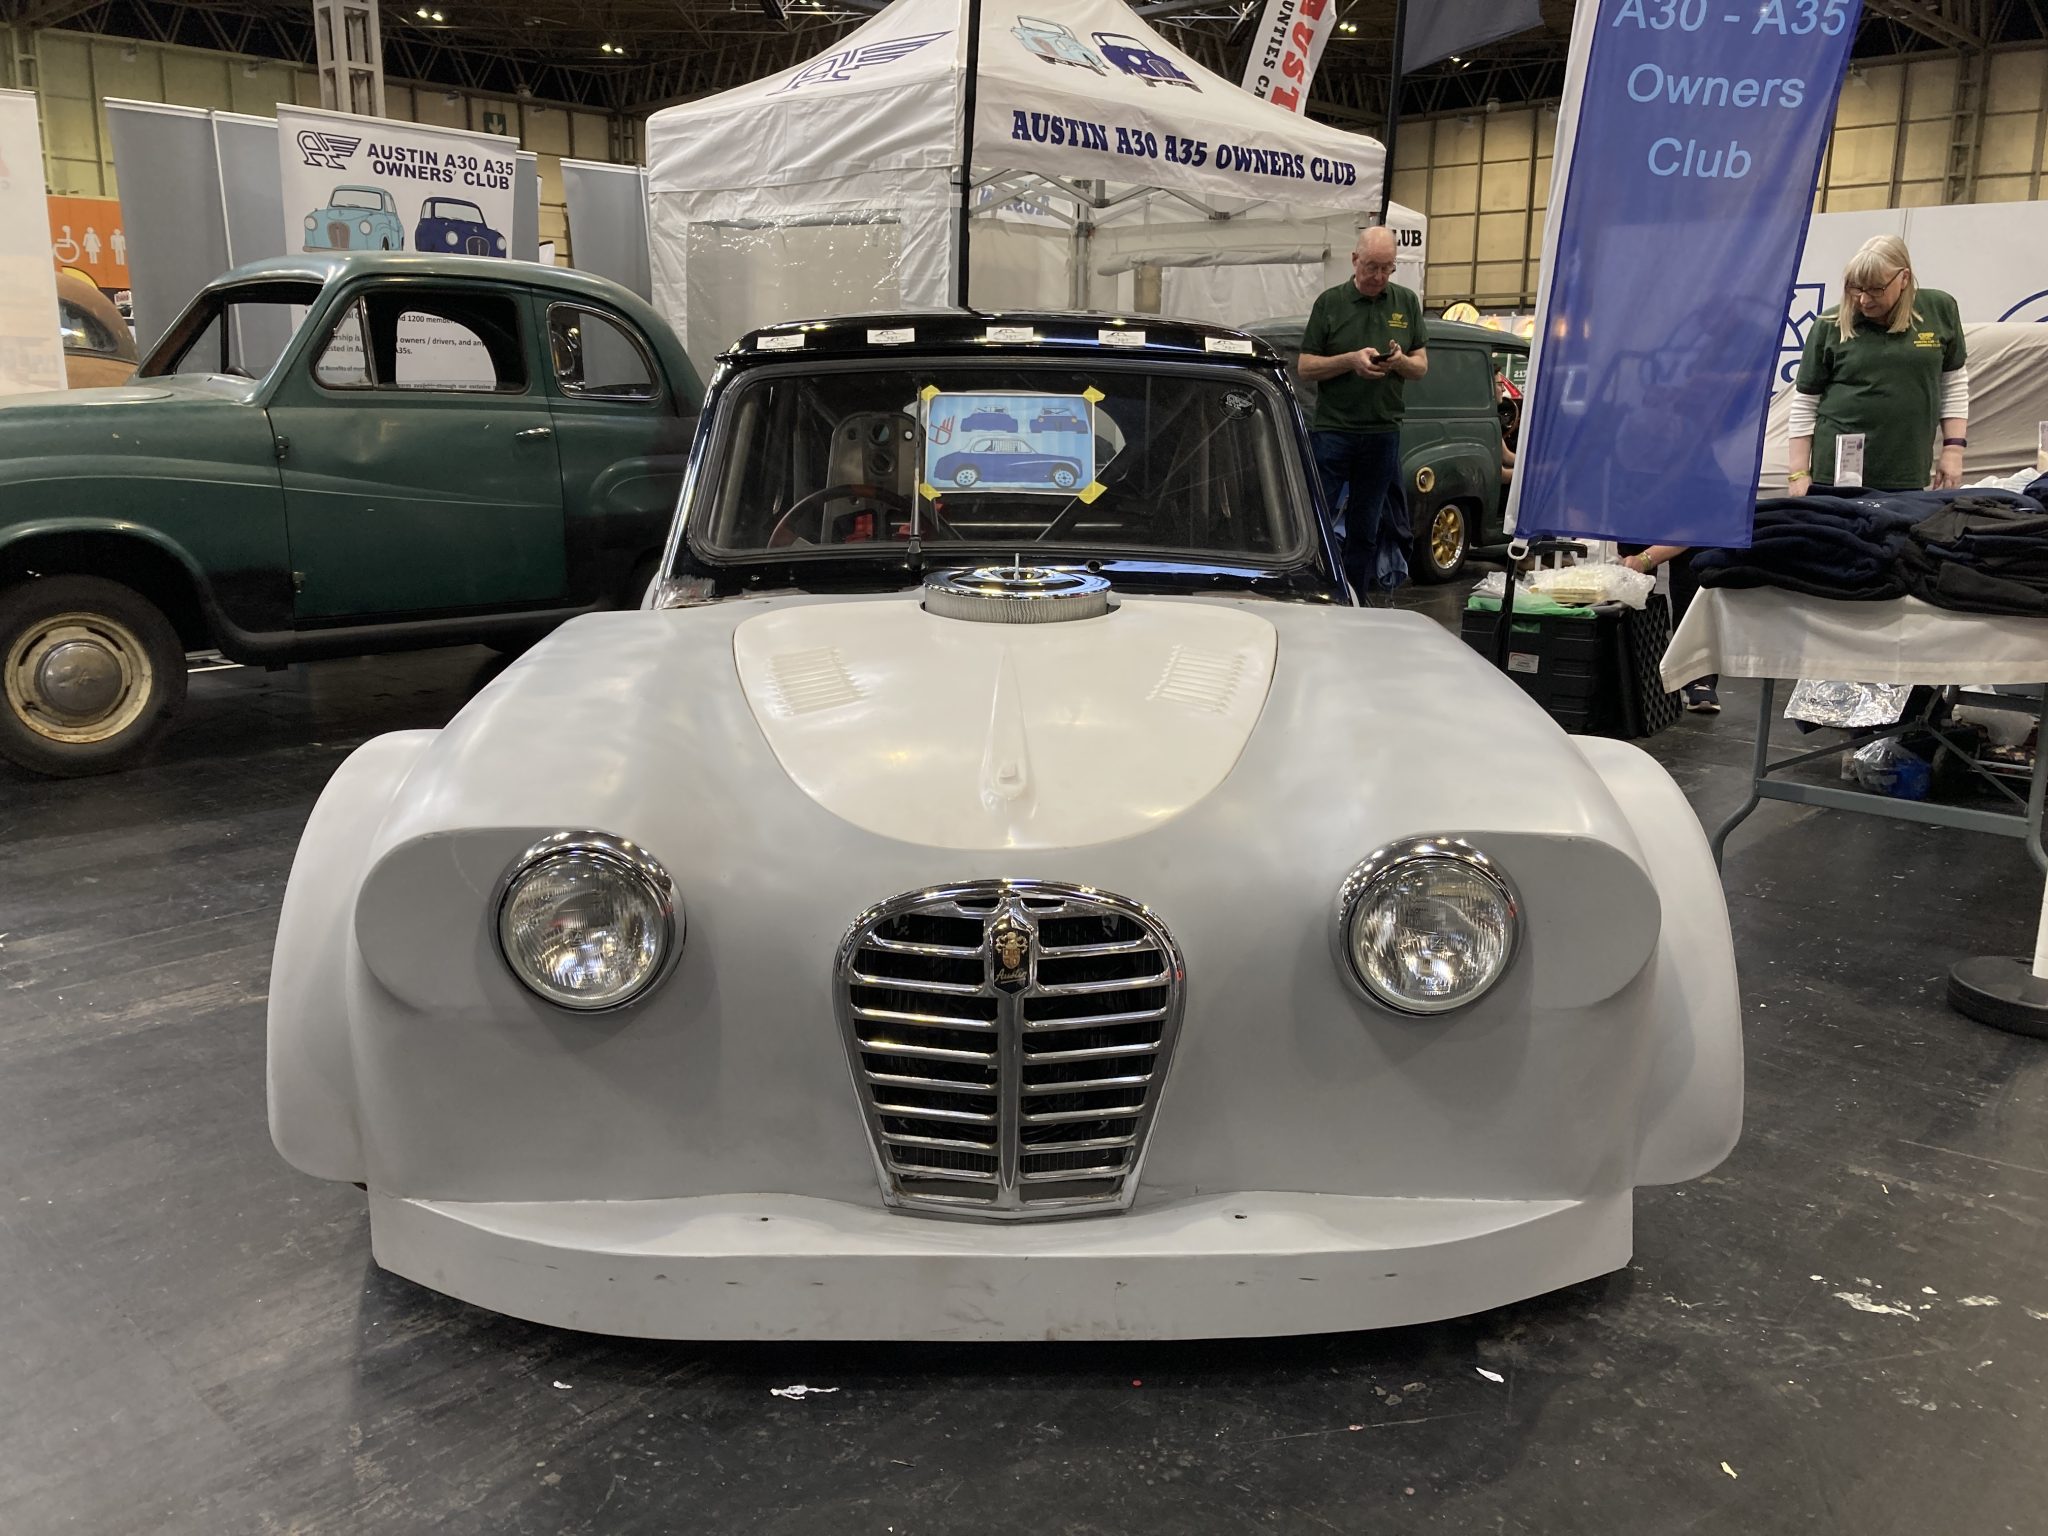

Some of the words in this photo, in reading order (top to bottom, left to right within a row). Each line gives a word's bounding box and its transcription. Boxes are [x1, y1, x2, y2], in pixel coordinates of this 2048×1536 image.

[1263, 0, 1295, 69] UNTIES
[1612, 0, 1707, 32] A30
[1751, 0, 1850, 36] A35
[1627, 63, 1806, 109] Owners
[366, 143, 438, 166] AUSTIN
[444, 153, 478, 171] A30
[483, 159, 514, 176] A35
[1011, 110, 1109, 152] AUSTIN
[1115, 127, 1157, 159] A30
[1164, 135, 1208, 167] A35
[1215, 144, 1305, 179] OWNERS
[1310, 157, 1357, 186] CLUB
[1647, 137, 1752, 179] Club
[463, 171, 510, 190] CLUB
[407, 315, 425, 323] 1200
[432, 337, 457, 346] drivers,
